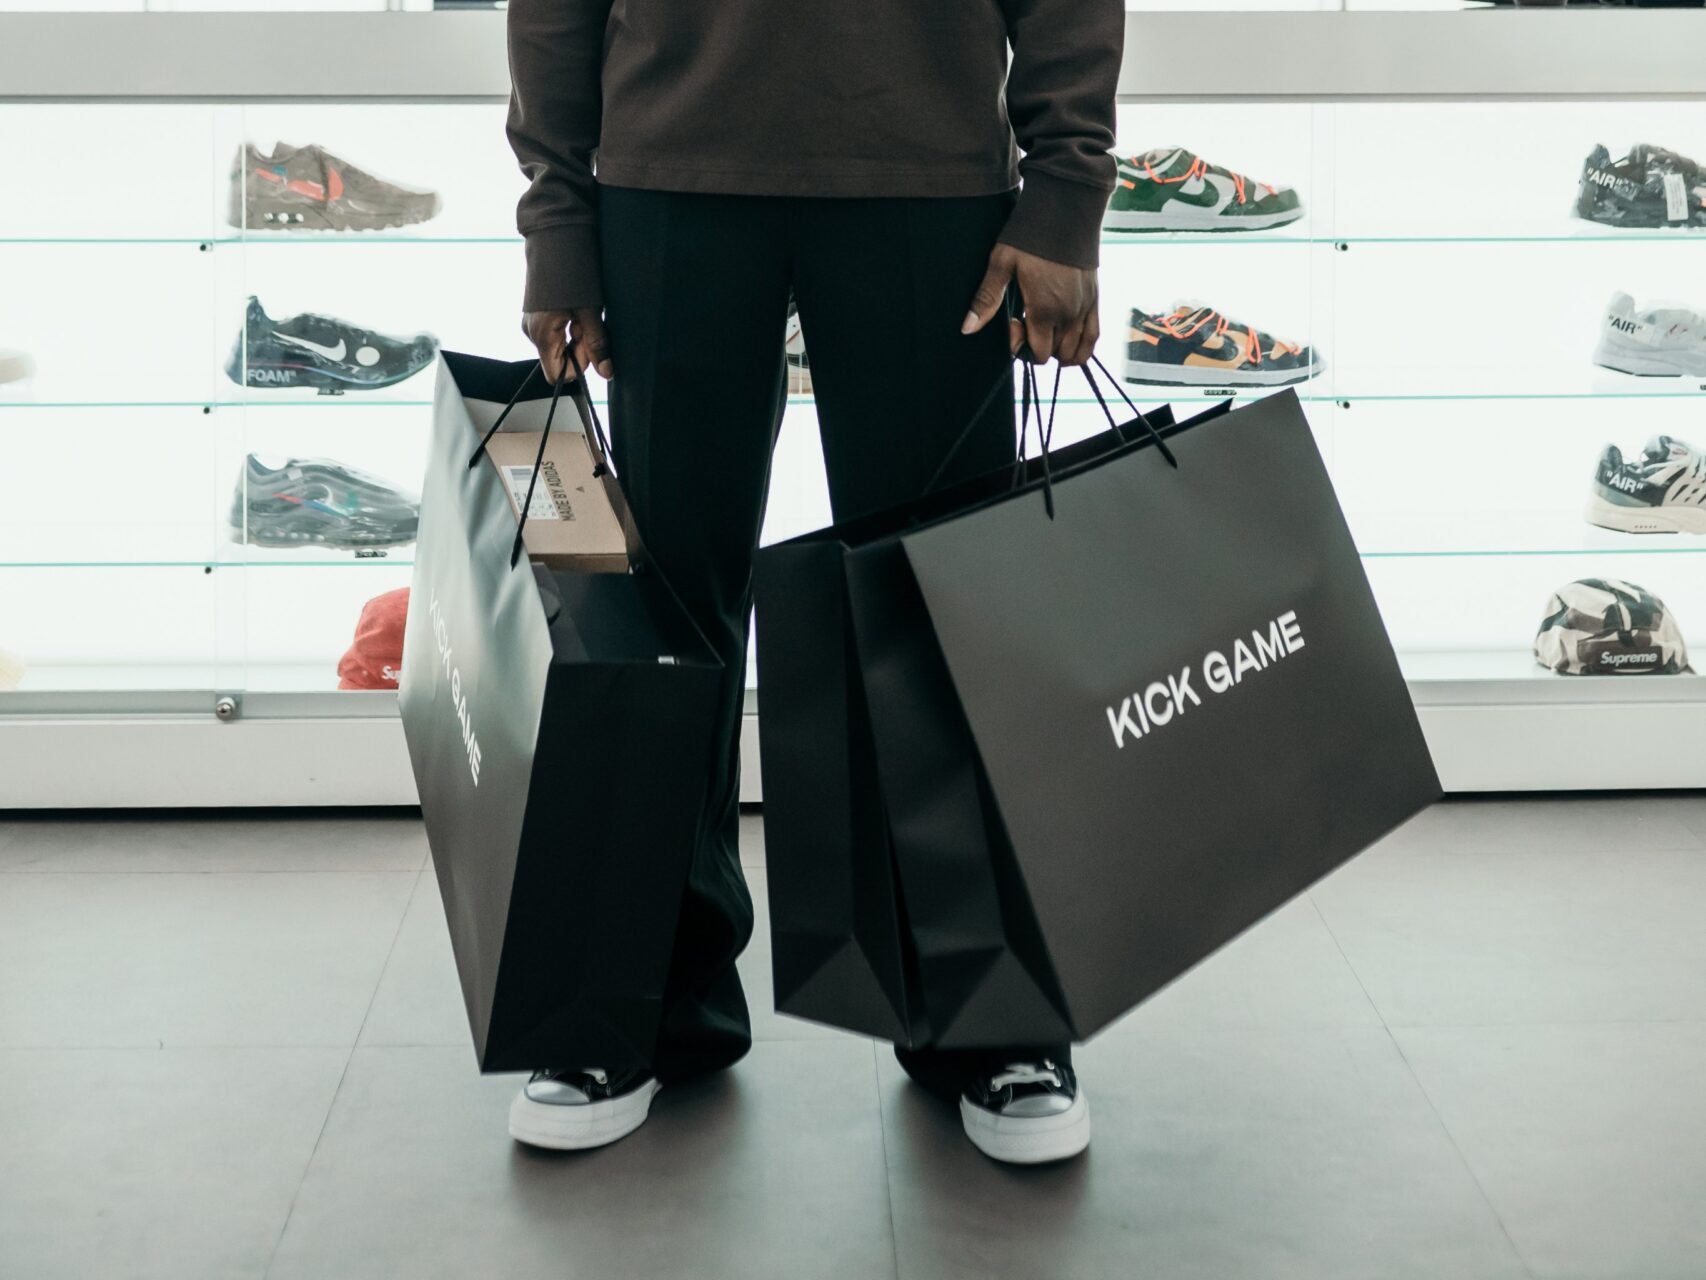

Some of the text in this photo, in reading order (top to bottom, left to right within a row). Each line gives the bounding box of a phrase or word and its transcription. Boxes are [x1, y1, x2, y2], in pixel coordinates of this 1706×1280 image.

[1587, 167, 1623, 189] "AIR"
[541, 460, 576, 522] MADE BY ADIDAS
[1606, 471, 1644, 494] "AIR"
[1106, 609, 1306, 750] KICK GAME
[1600, 651, 1658, 666] Supreme
[429, 587, 482, 788] KICK GAME
